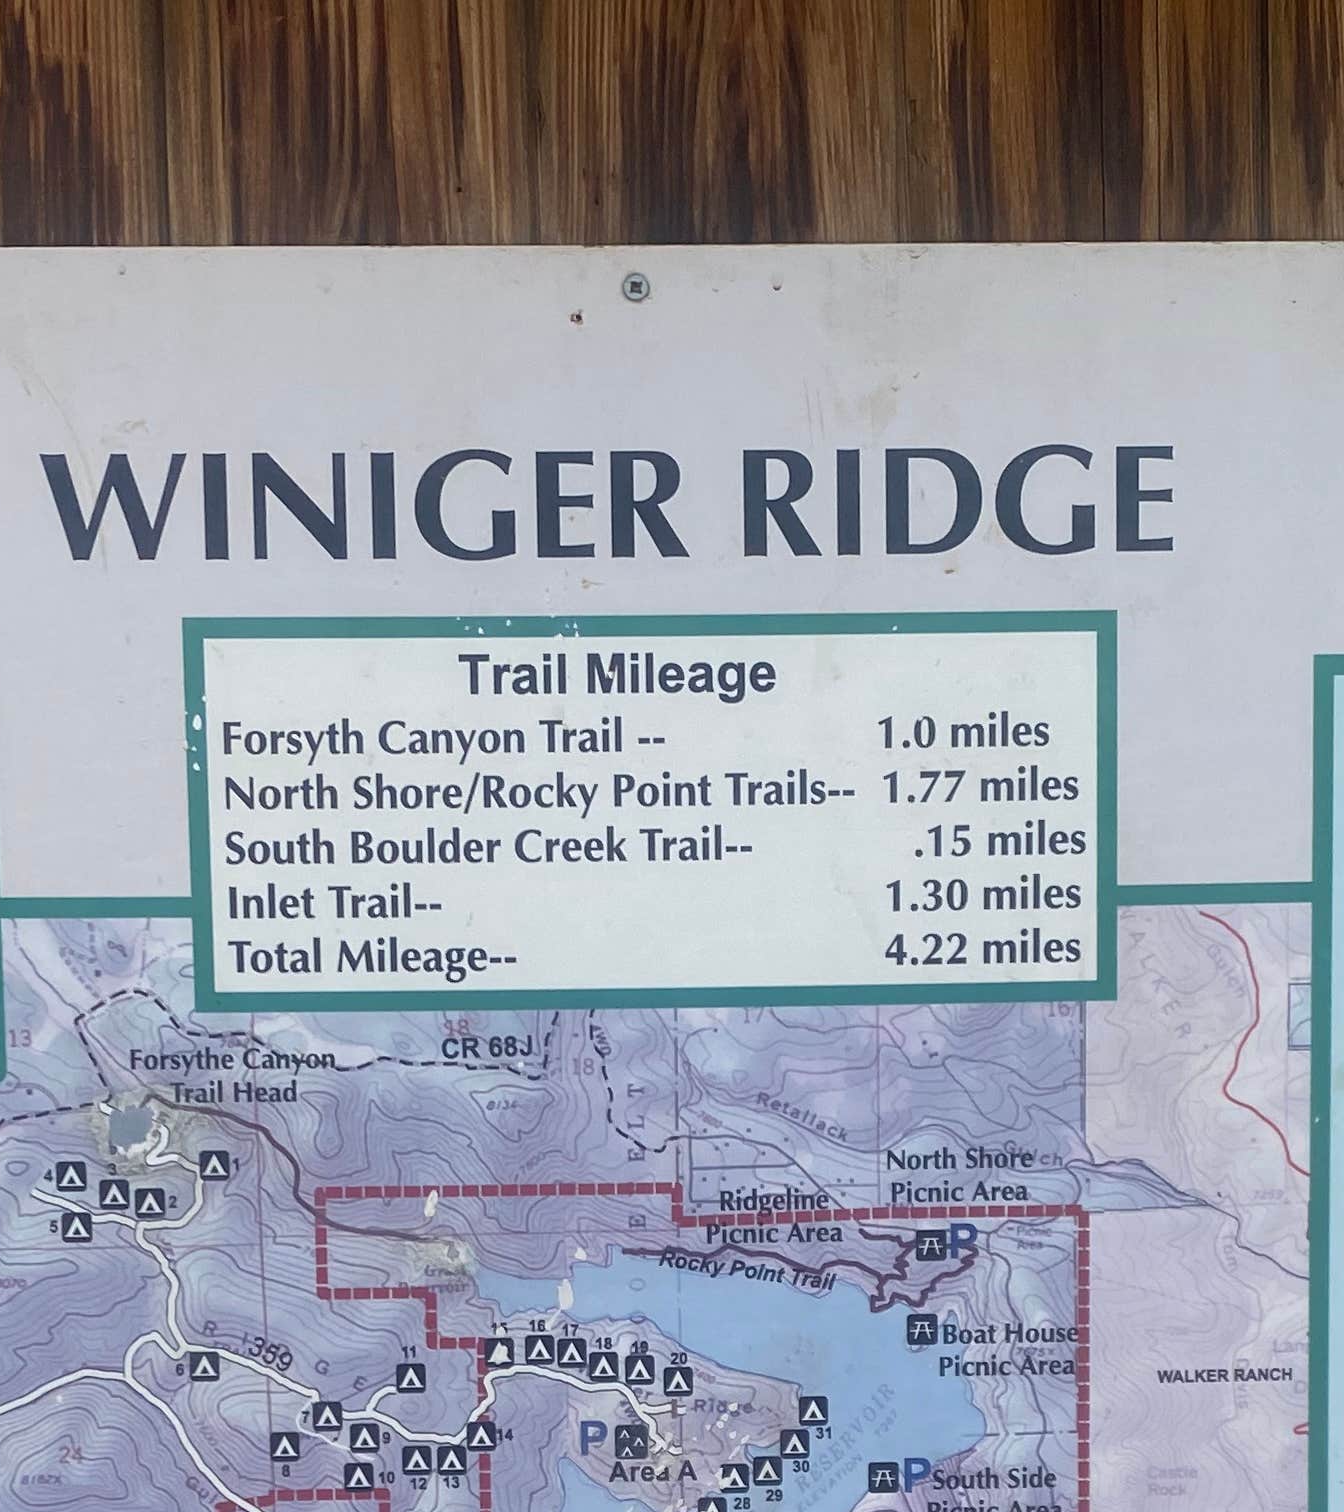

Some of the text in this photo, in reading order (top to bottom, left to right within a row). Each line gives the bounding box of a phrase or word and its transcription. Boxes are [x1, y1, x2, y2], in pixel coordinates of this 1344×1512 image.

[40, 444, 1173, 561] WINIGER RIDGE
[458, 653, 776, 703] Trail Mileage
[223, 718, 363, 766] Forsyth
[379, 721, 524, 765] Canyon
[539, 716, 622, 752] Trail
[878, 716, 935, 748] 1.0
[951, 711, 1049, 747] miles
[225, 774, 338, 810] North
[354, 772, 598, 819] Shore/Rocky
[614, 772, 711, 807] Point
[883, 770, 965, 803] 1.77
[981, 765, 1078, 801] miles
[226, 828, 334, 865] South
[351, 827, 501, 864] Boulder
[515, 826, 626, 863] Creek
[915, 825, 971, 857] .15
[989, 819, 1086, 855] miles
[229, 883, 315, 919] Inlet
[887, 879, 968, 911] 1.30
[984, 873, 1081, 910] miles
[228, 937, 321, 973] Total
[885, 933, 966, 965] 4.22
[983, 928, 1080, 964] miles
[129, 1049, 336, 1076] Forsythe Canyon
[171, 1082, 297, 1103] Trail Head
[886, 1148, 1033, 1170] North Shore
[719, 1189, 830, 1217] Ridgeline
[890, 1182, 1029, 1203] Picnic Area
[706, 1222, 844, 1244] Picnic Area
[658, 1251, 836, 1291] Rocky Point Trail
[943, 1323, 1079, 1345] Boat House
[938, 1355, 1076, 1376] Picnic Area
[1157, 1367, 1294, 1384] WALKER RANCH
